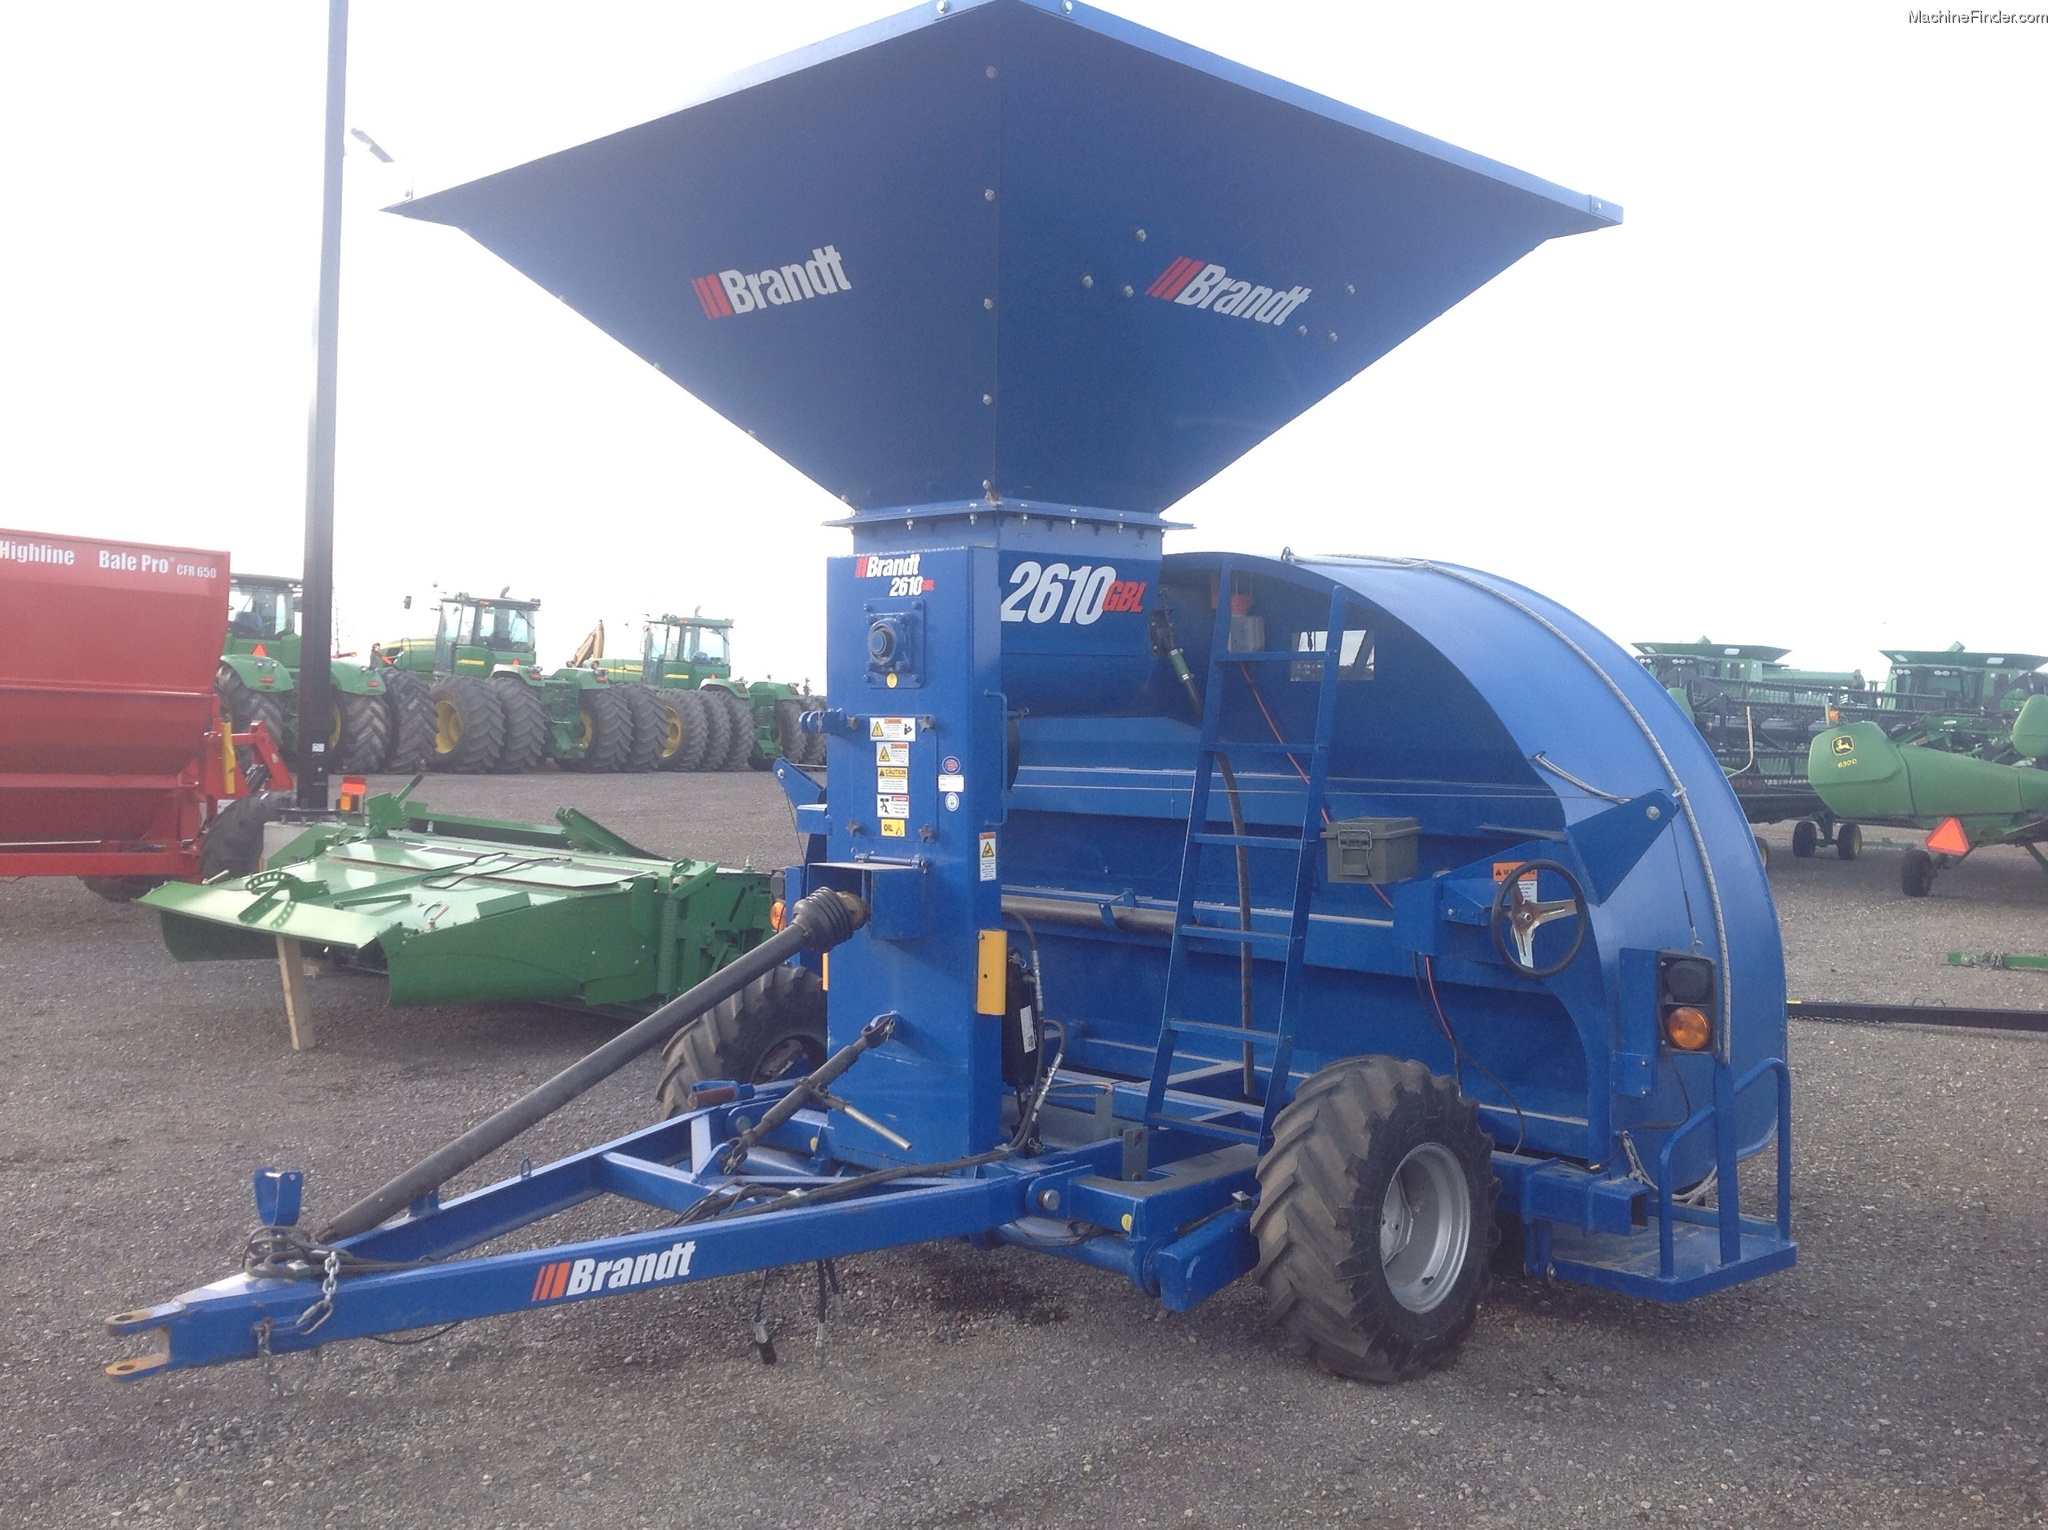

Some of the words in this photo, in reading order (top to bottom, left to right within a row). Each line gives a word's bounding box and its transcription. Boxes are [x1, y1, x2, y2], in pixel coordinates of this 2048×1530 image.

[718, 244, 852, 315] Brandt
[1174, 263, 1312, 326] Brandt
[0, 540, 75, 565] Highline
[98, 549, 137, 571] Bale
[176, 563, 195, 577] CFR
[196, 566, 217, 579] 650
[866, 553, 921, 578] Brandt
[885, 768, 907, 777] CAUTION
[883, 823, 894, 833] OIL
[565, 1240, 697, 1297] Brandt
